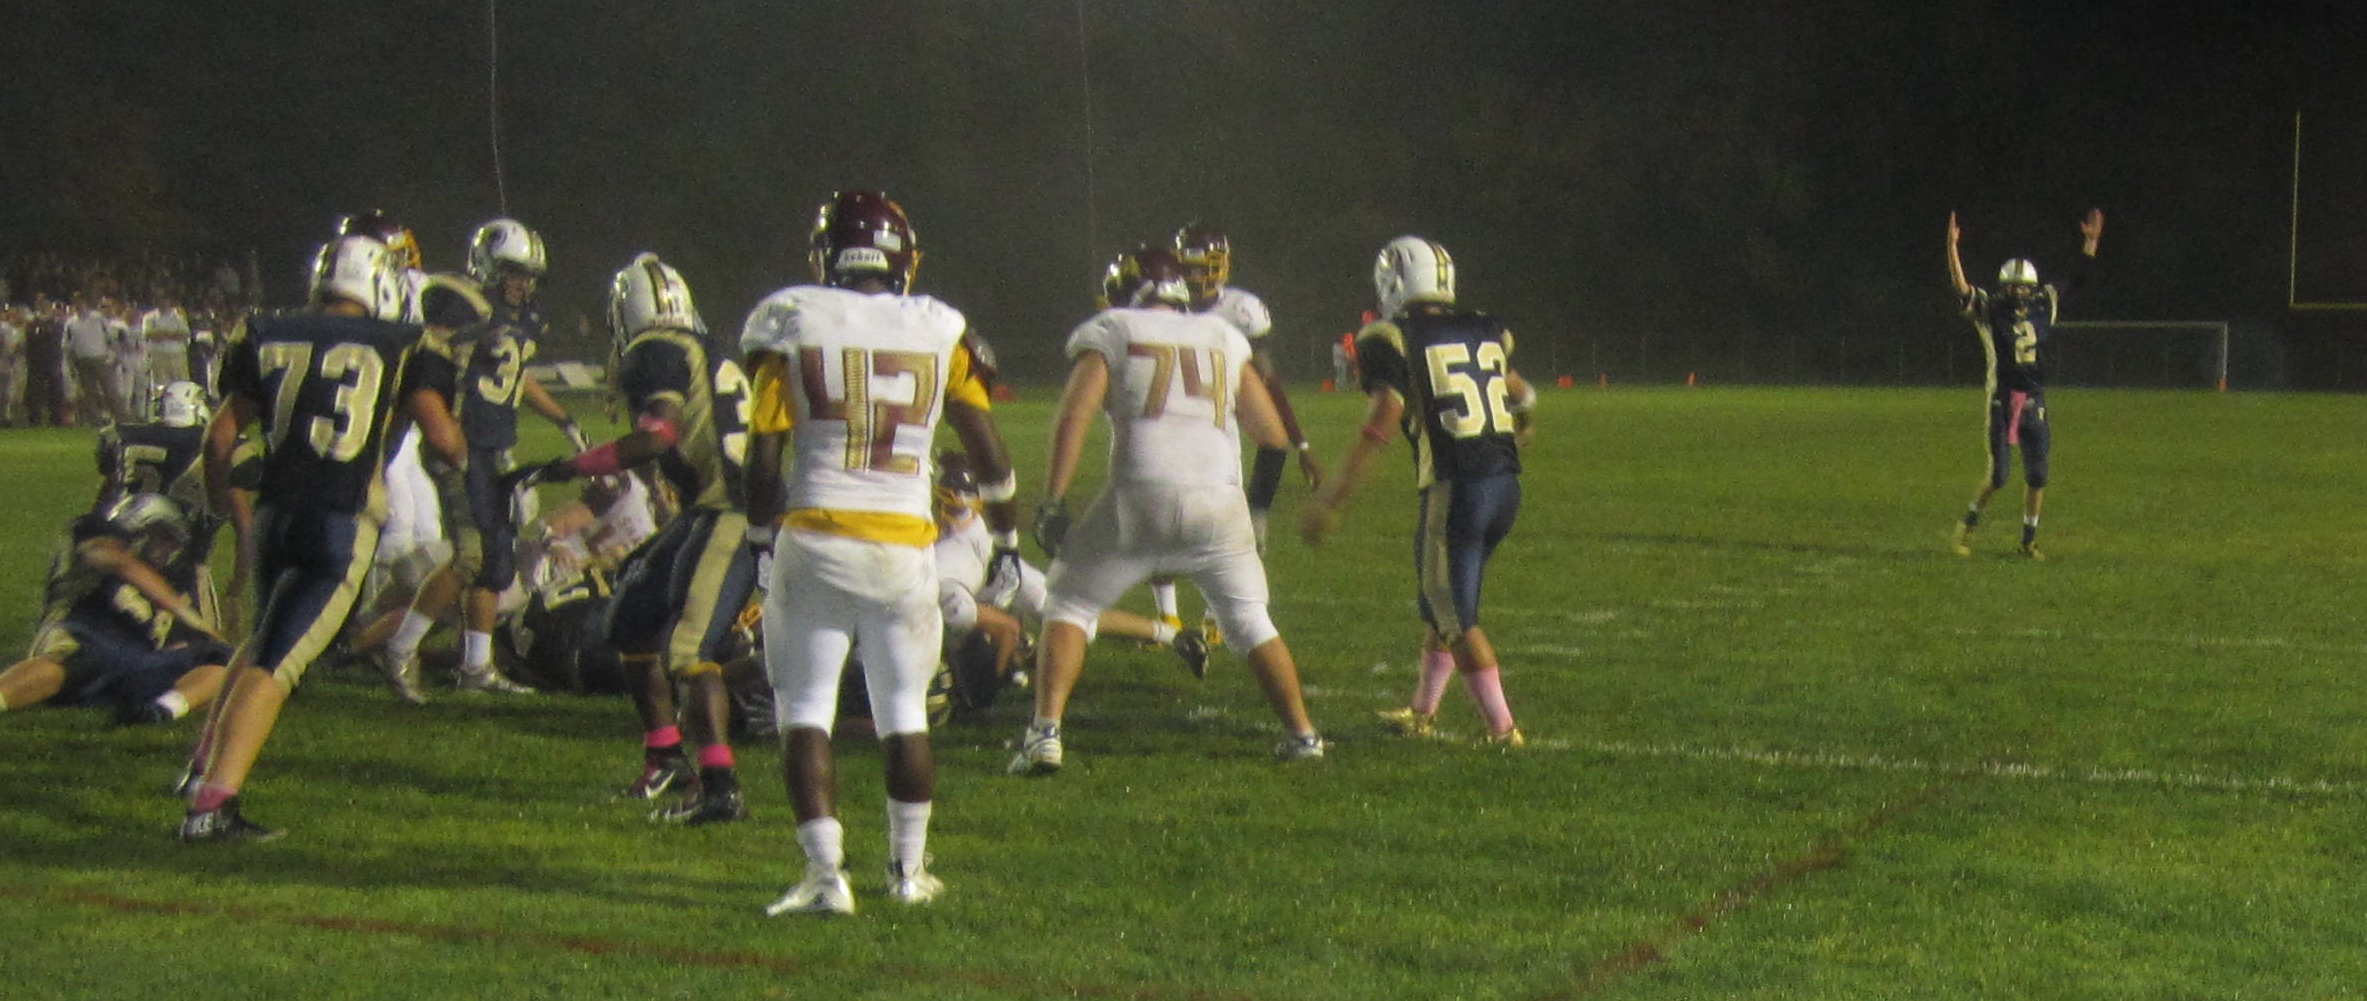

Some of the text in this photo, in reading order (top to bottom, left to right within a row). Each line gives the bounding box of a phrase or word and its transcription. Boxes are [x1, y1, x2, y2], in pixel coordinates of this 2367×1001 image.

[1127, 342, 1227, 430] 74
[1425, 341, 1515, 439] 52
[2012, 320, 2037, 363] 2
[259, 341, 384, 463] 73
[800, 344, 938, 476] 42
